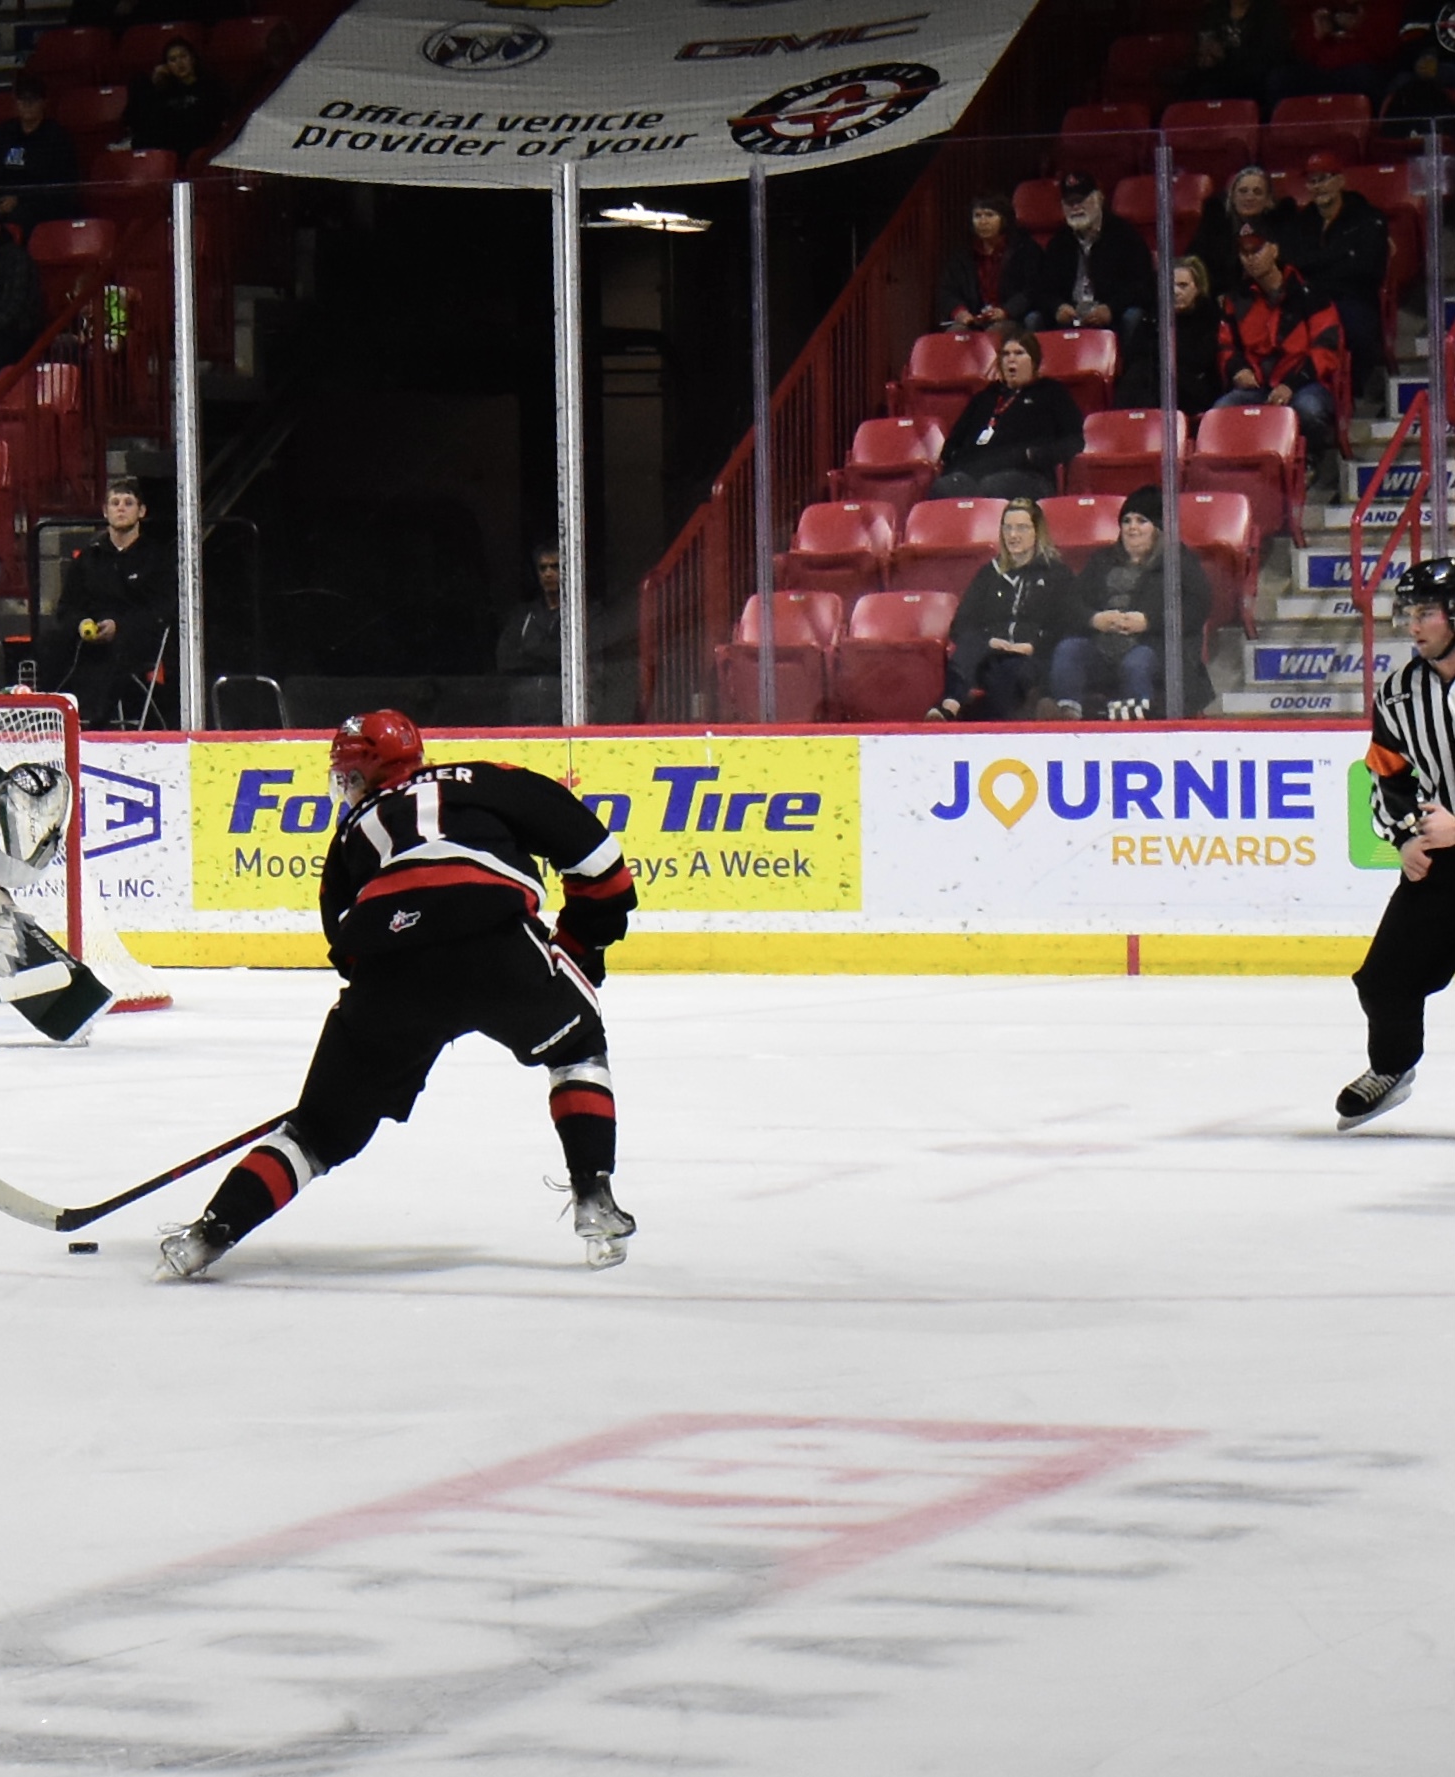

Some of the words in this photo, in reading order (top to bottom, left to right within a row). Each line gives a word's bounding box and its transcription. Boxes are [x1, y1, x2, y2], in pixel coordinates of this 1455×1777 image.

[675, 12, 931, 61] GMC
[318, 101, 485, 131] Official
[497, 110, 665, 133] vehicle
[292, 123, 505, 158] provider
[515, 135, 575, 158] of
[575, 131, 699, 161] your
[1269, 696, 1332, 709] ODOUR
[652, 766, 822, 832] Tire
[929, 758, 1315, 830] JOURNIE
[353, 780, 446, 869] 11
[235, 847, 327, 878] Moos
[628, 851, 678, 886] ays
[689, 851, 712, 877] A
[719, 849, 812, 878] Week
[1111, 835, 1318, 867] REWARDS
[118, 879, 162, 898] INC.
